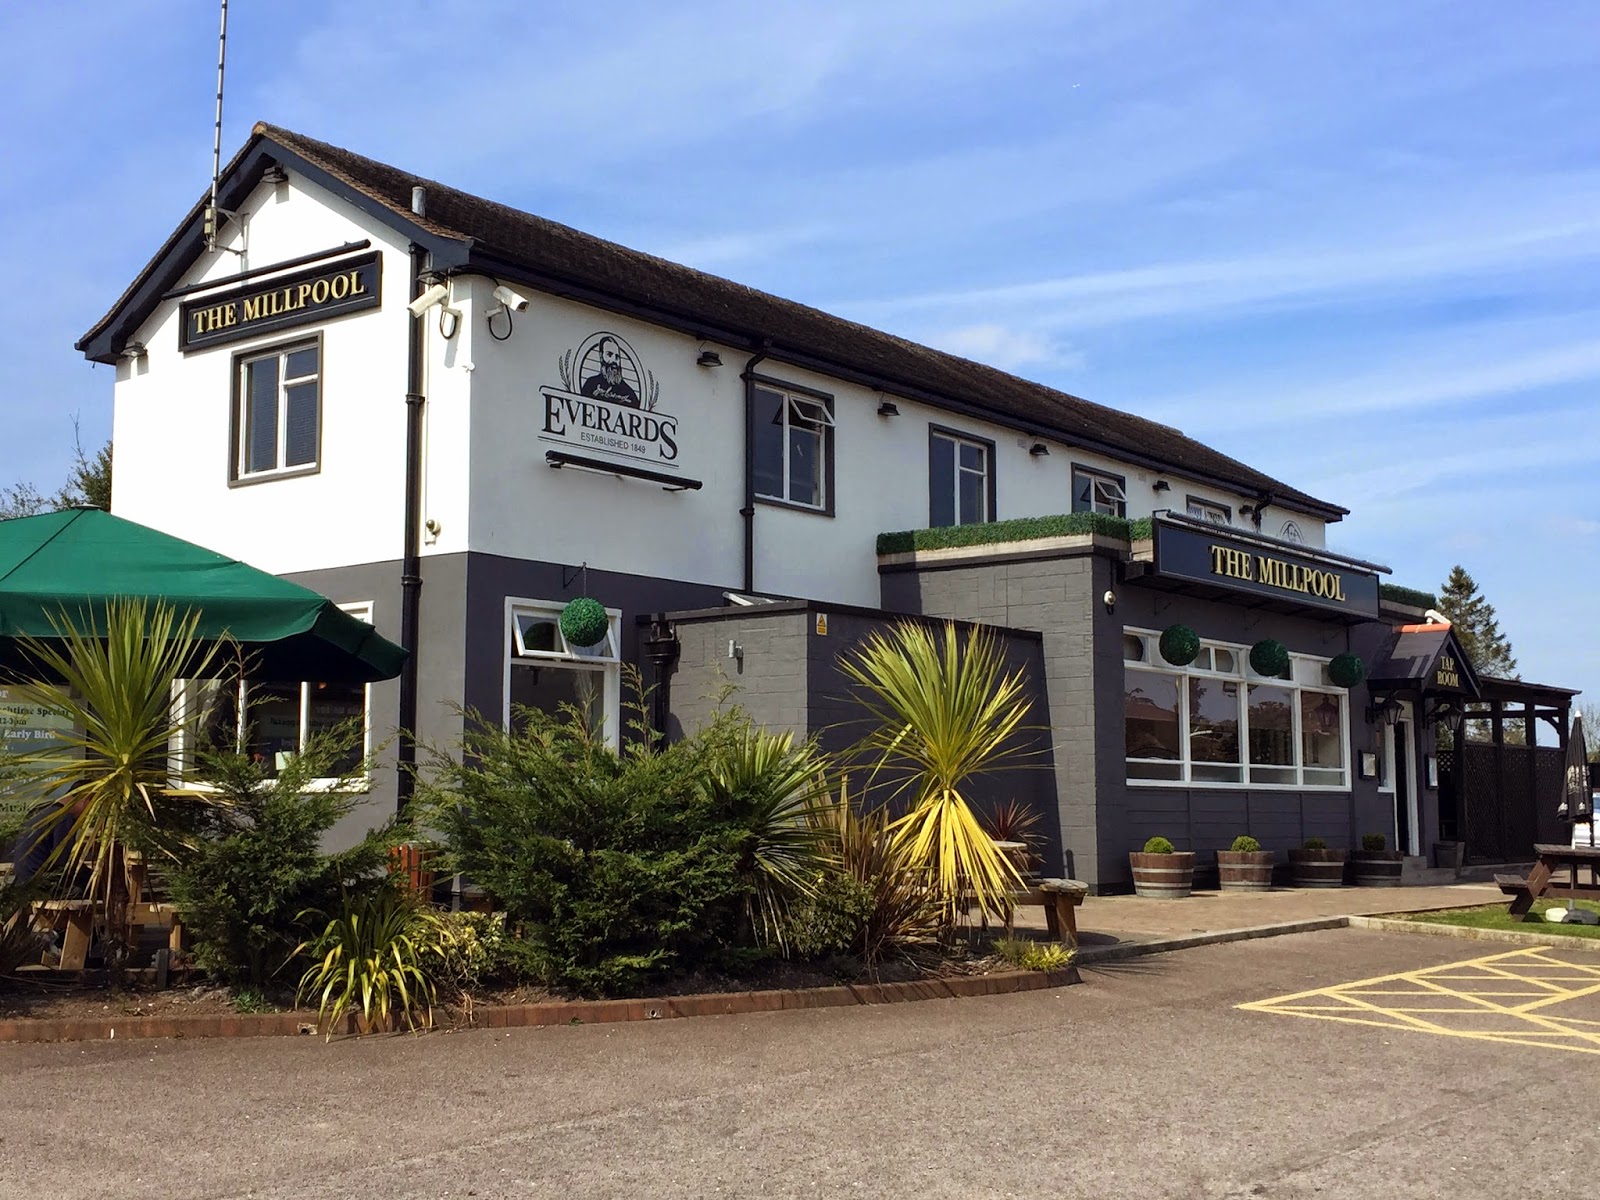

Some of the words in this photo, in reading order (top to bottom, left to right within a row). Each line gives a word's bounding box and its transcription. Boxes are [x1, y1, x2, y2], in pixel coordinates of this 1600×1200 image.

[193, 302, 236, 334] THE
[242, 271, 365, 322] MILLPOOL
[541, 393, 678, 460] EVERARDS
[580, 432, 629, 450] ESTABLISHED
[630, 443, 646, 454] 1849
[1211, 545, 1252, 581] THE
[1258, 556, 1346, 601] MILLPOOL
[1437, 671, 1459, 687] ROOM
[1440, 656, 1455, 671] TAP
